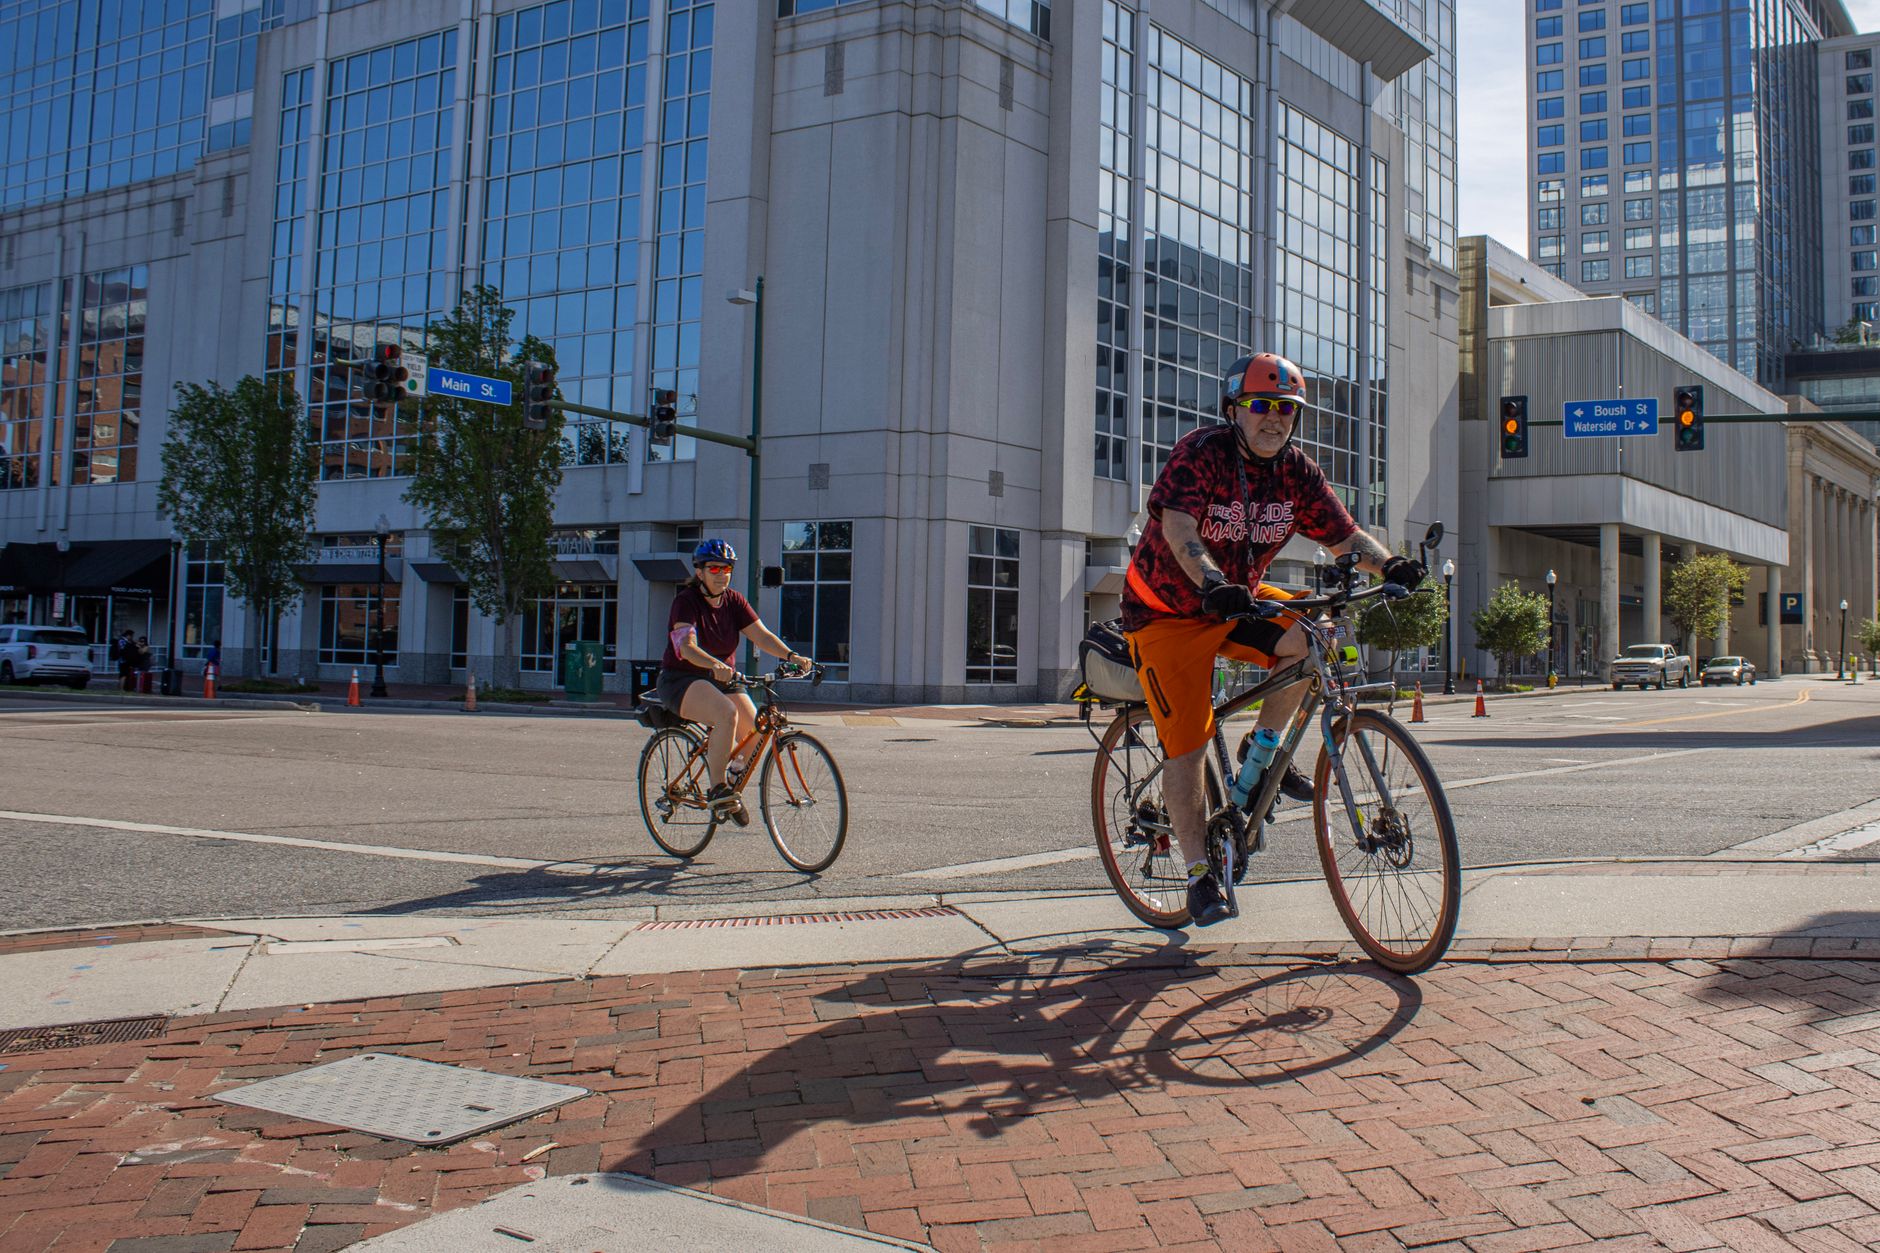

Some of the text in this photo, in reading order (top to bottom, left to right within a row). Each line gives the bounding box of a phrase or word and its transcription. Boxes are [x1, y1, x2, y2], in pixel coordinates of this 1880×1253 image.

[441, 377, 497, 397] Main St.
[1594, 403, 1648, 416] Boush St
[1573, 420, 1635, 432] Waterside Dr
[1208, 504, 1232, 519] THE
[557, 537, 595, 555] MAIN
[1786, 597, 1798, 610] P
